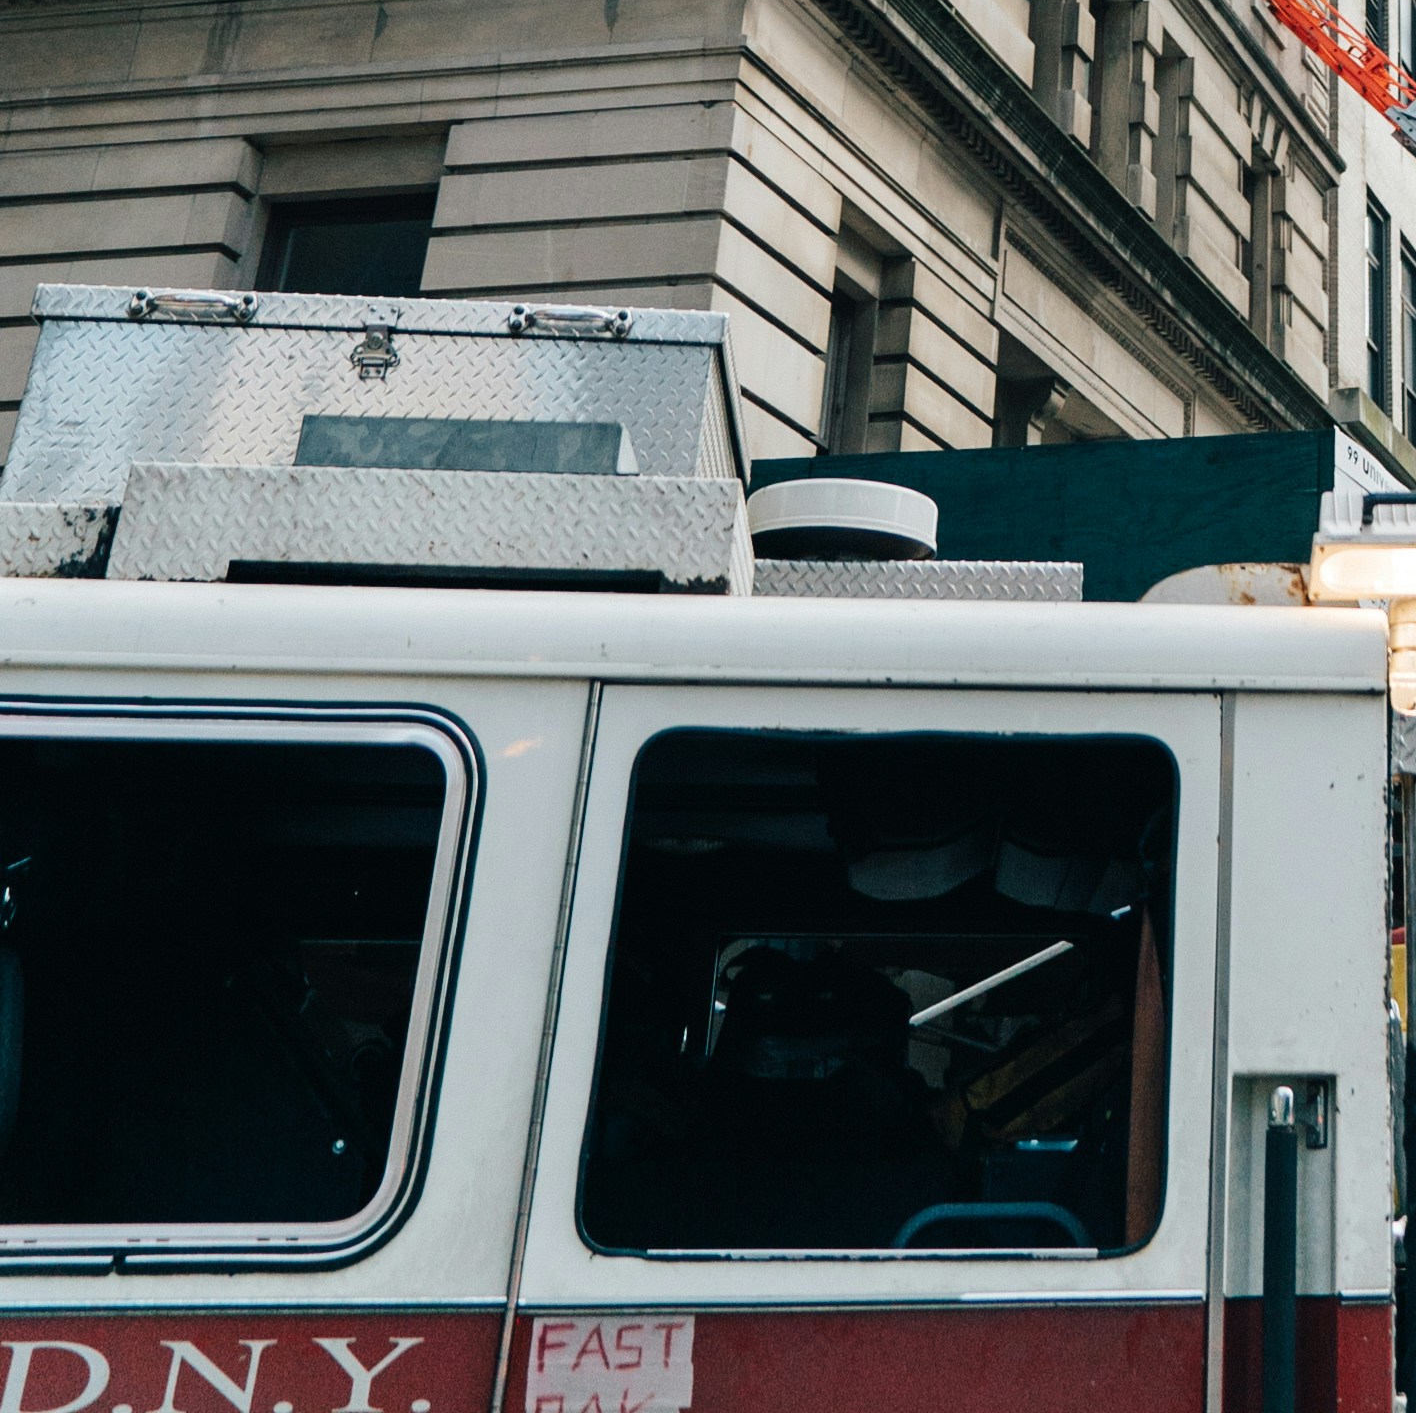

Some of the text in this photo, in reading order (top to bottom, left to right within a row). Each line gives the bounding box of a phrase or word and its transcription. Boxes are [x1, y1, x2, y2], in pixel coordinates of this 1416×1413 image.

[1347, 445, 1359, 465] 99
[537, 1322, 685, 1373] FAST
[0, 1337, 431, 1413] D.N.Y.
